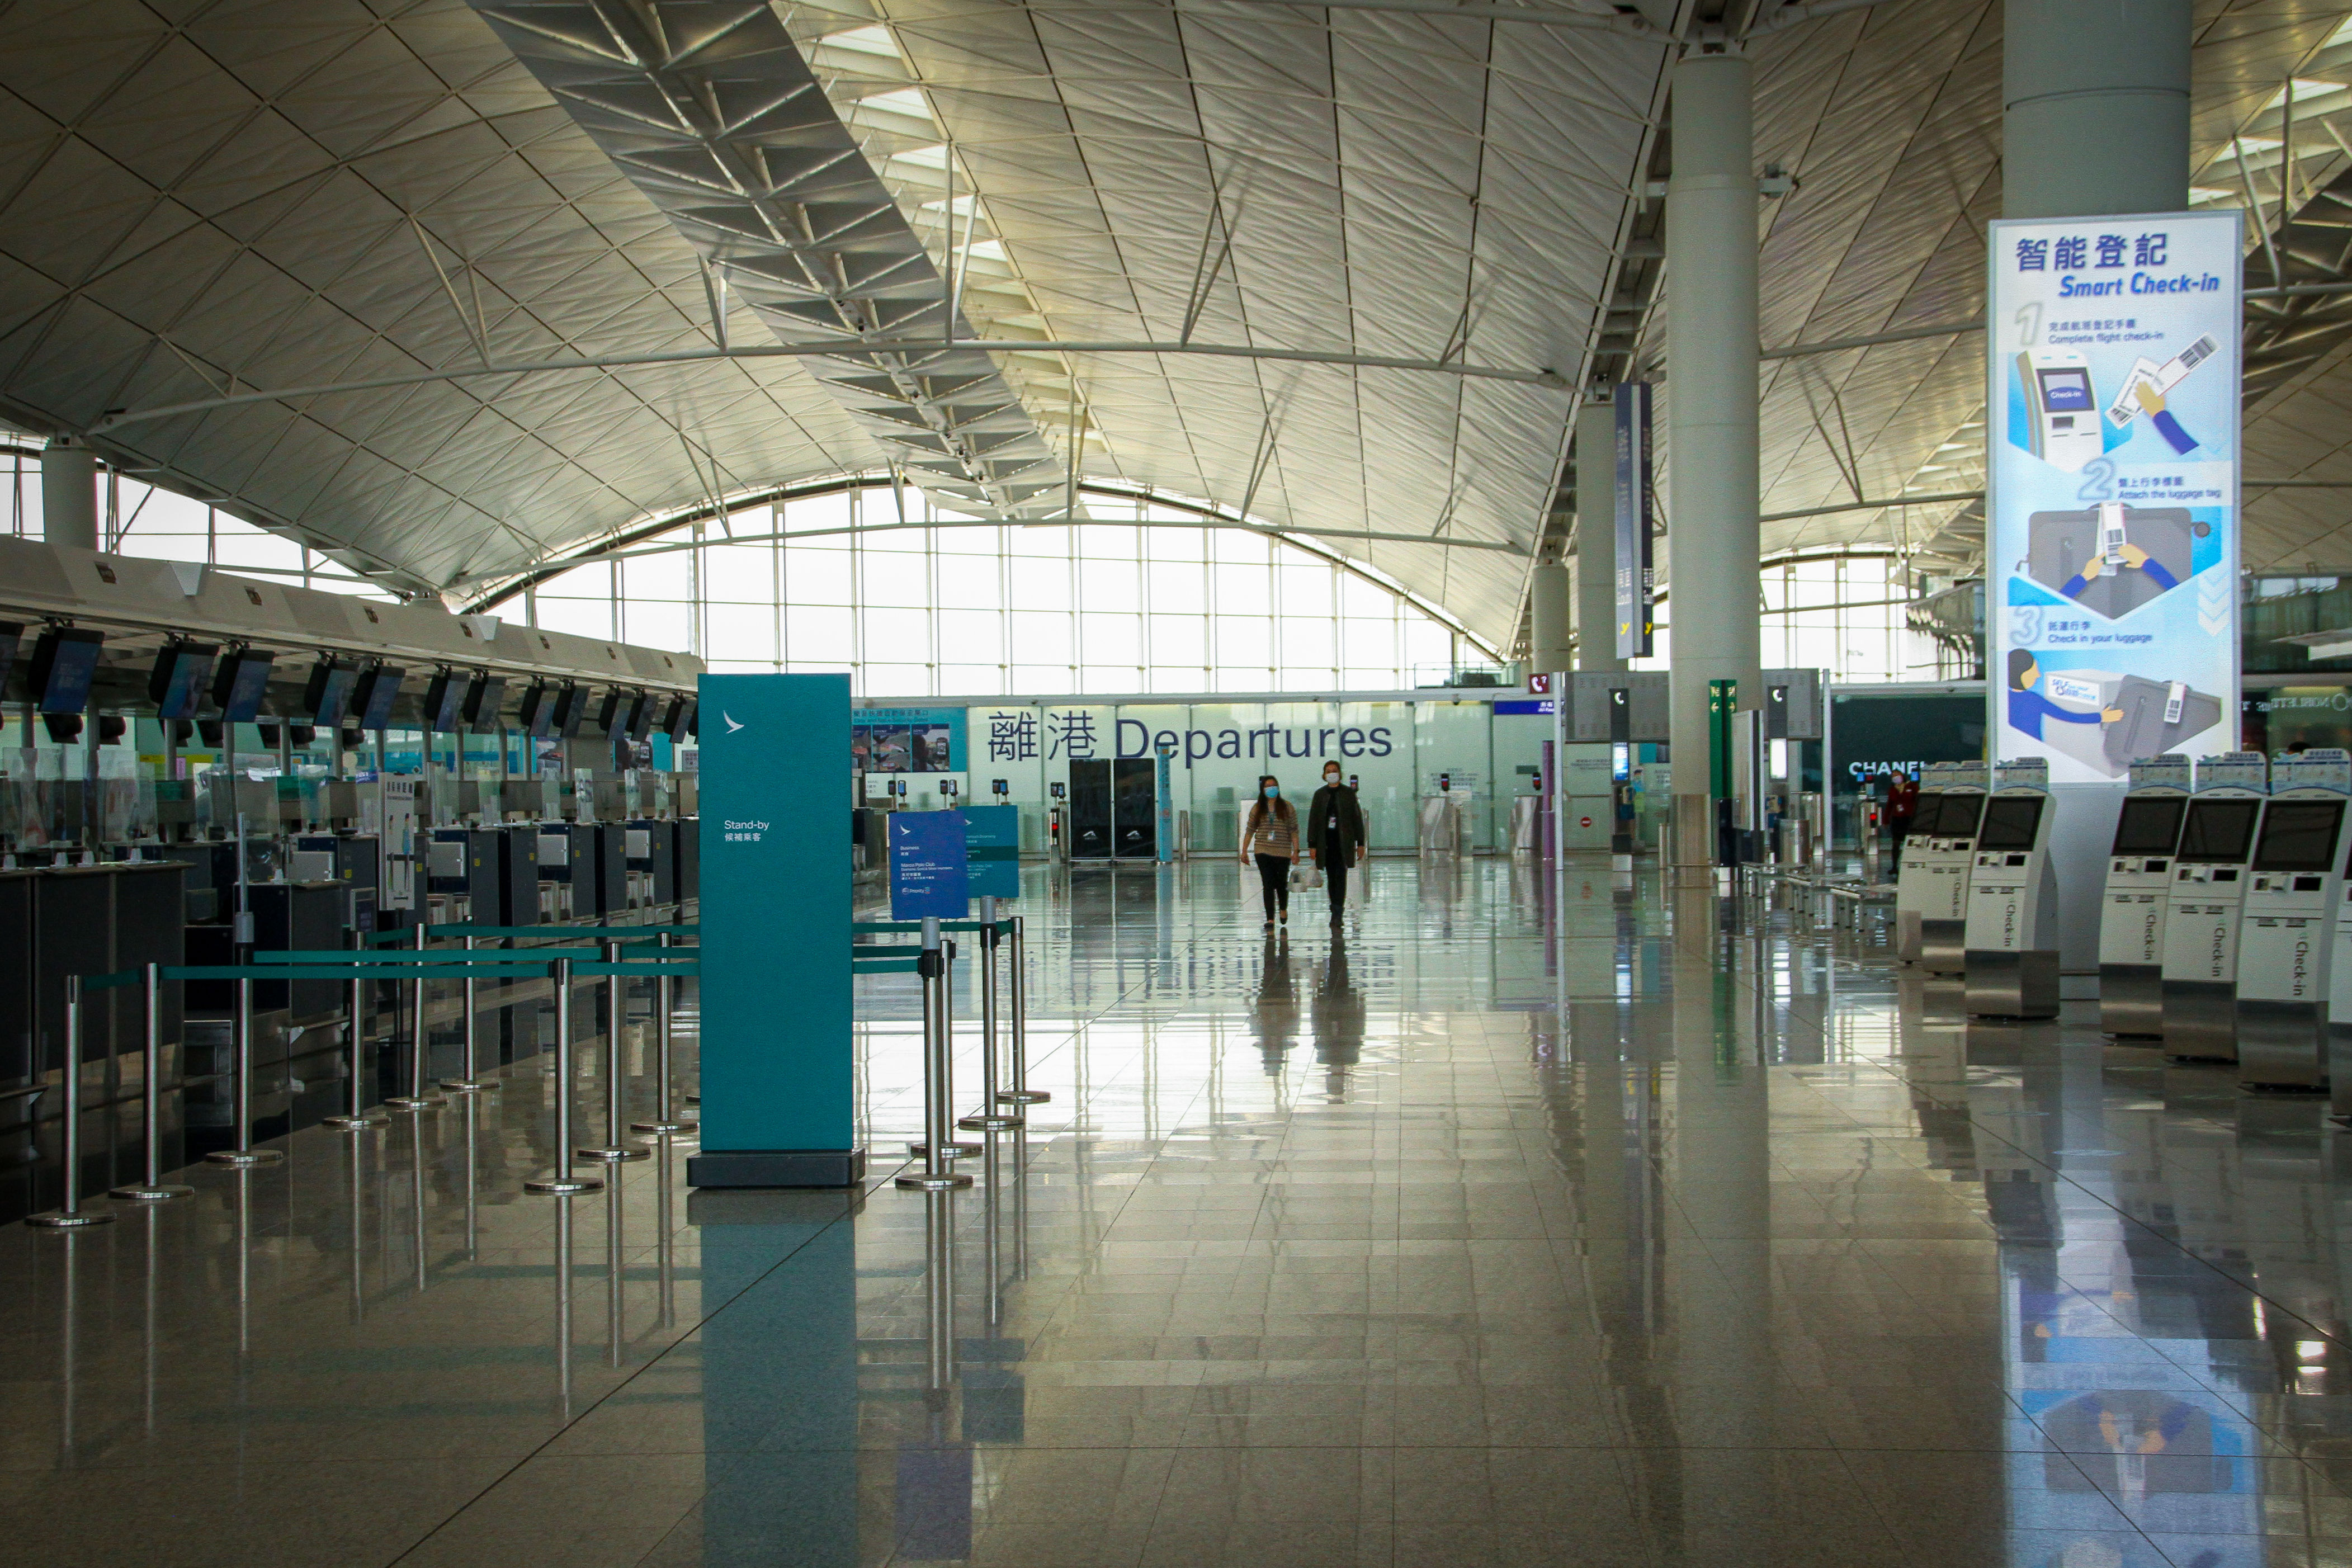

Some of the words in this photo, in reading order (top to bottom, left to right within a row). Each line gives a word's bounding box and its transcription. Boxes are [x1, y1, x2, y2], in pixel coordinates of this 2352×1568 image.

[2016, 233, 2168, 272] 智能登記
[2059, 275, 2124, 297] Smart
[2131, 272, 2220, 295] Check-in
[2015, 301, 2044, 347] 1
[2048, 334, 2094, 344] Complete
[2096, 333, 2120, 344] flight
[2123, 331, 2164, 342] check-in
[2078, 458, 2116, 500] 2
[2118, 490, 2148, 499] Attach
[2167, 490, 2203, 499] luggage
[2206, 490, 2221, 498] tag
[2010, 602, 2043, 645] 3
[2048, 634, 2077, 643] Check
[2080, 634, 2089, 642] in
[2090, 635, 2112, 644] your
[2115, 634, 2153, 644] luggage
[988, 710, 1098, 763] 離港
[1117, 719, 1392, 770] Departures
[724, 820, 769, 831] Stand-by
